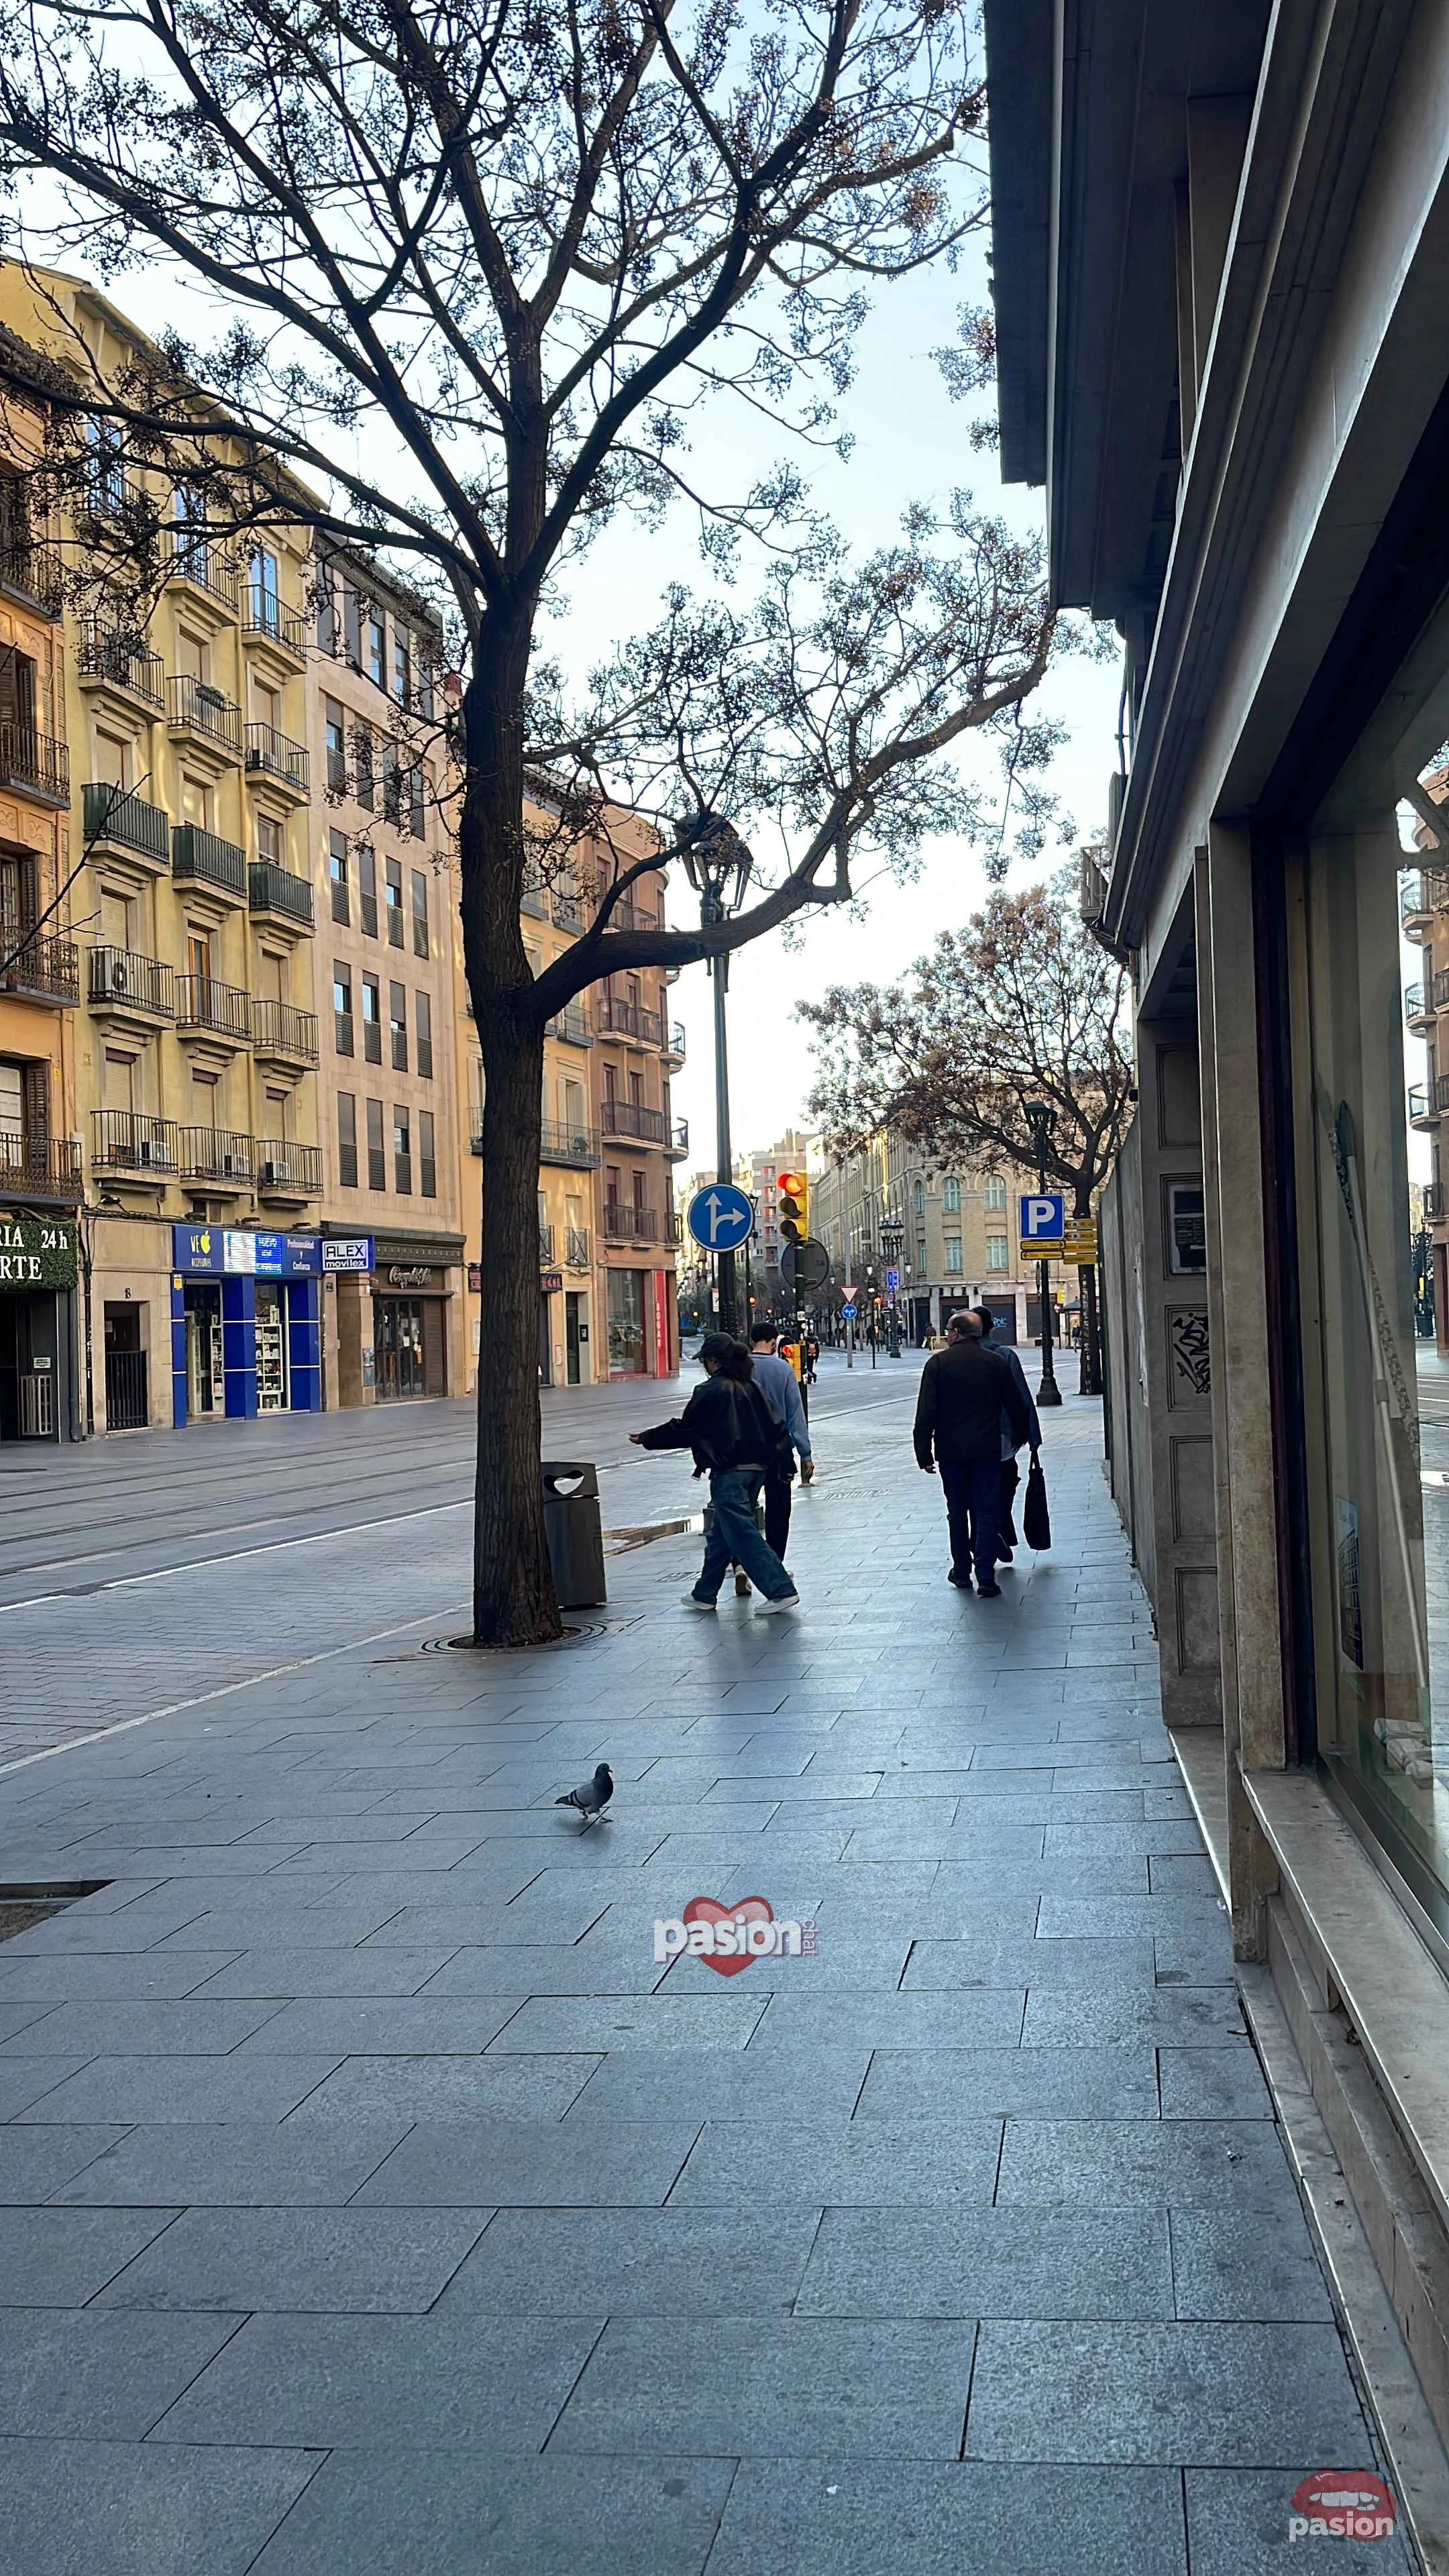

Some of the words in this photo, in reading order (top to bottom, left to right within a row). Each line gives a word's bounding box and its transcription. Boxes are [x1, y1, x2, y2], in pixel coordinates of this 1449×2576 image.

[1028, 1199, 1055, 1234] P
[0, 1226, 25, 1248] IA
[326, 1244, 364, 1258] ALEX
[0, 1255, 42, 1279] RTE
[326, 1259, 365, 1268] movilex
